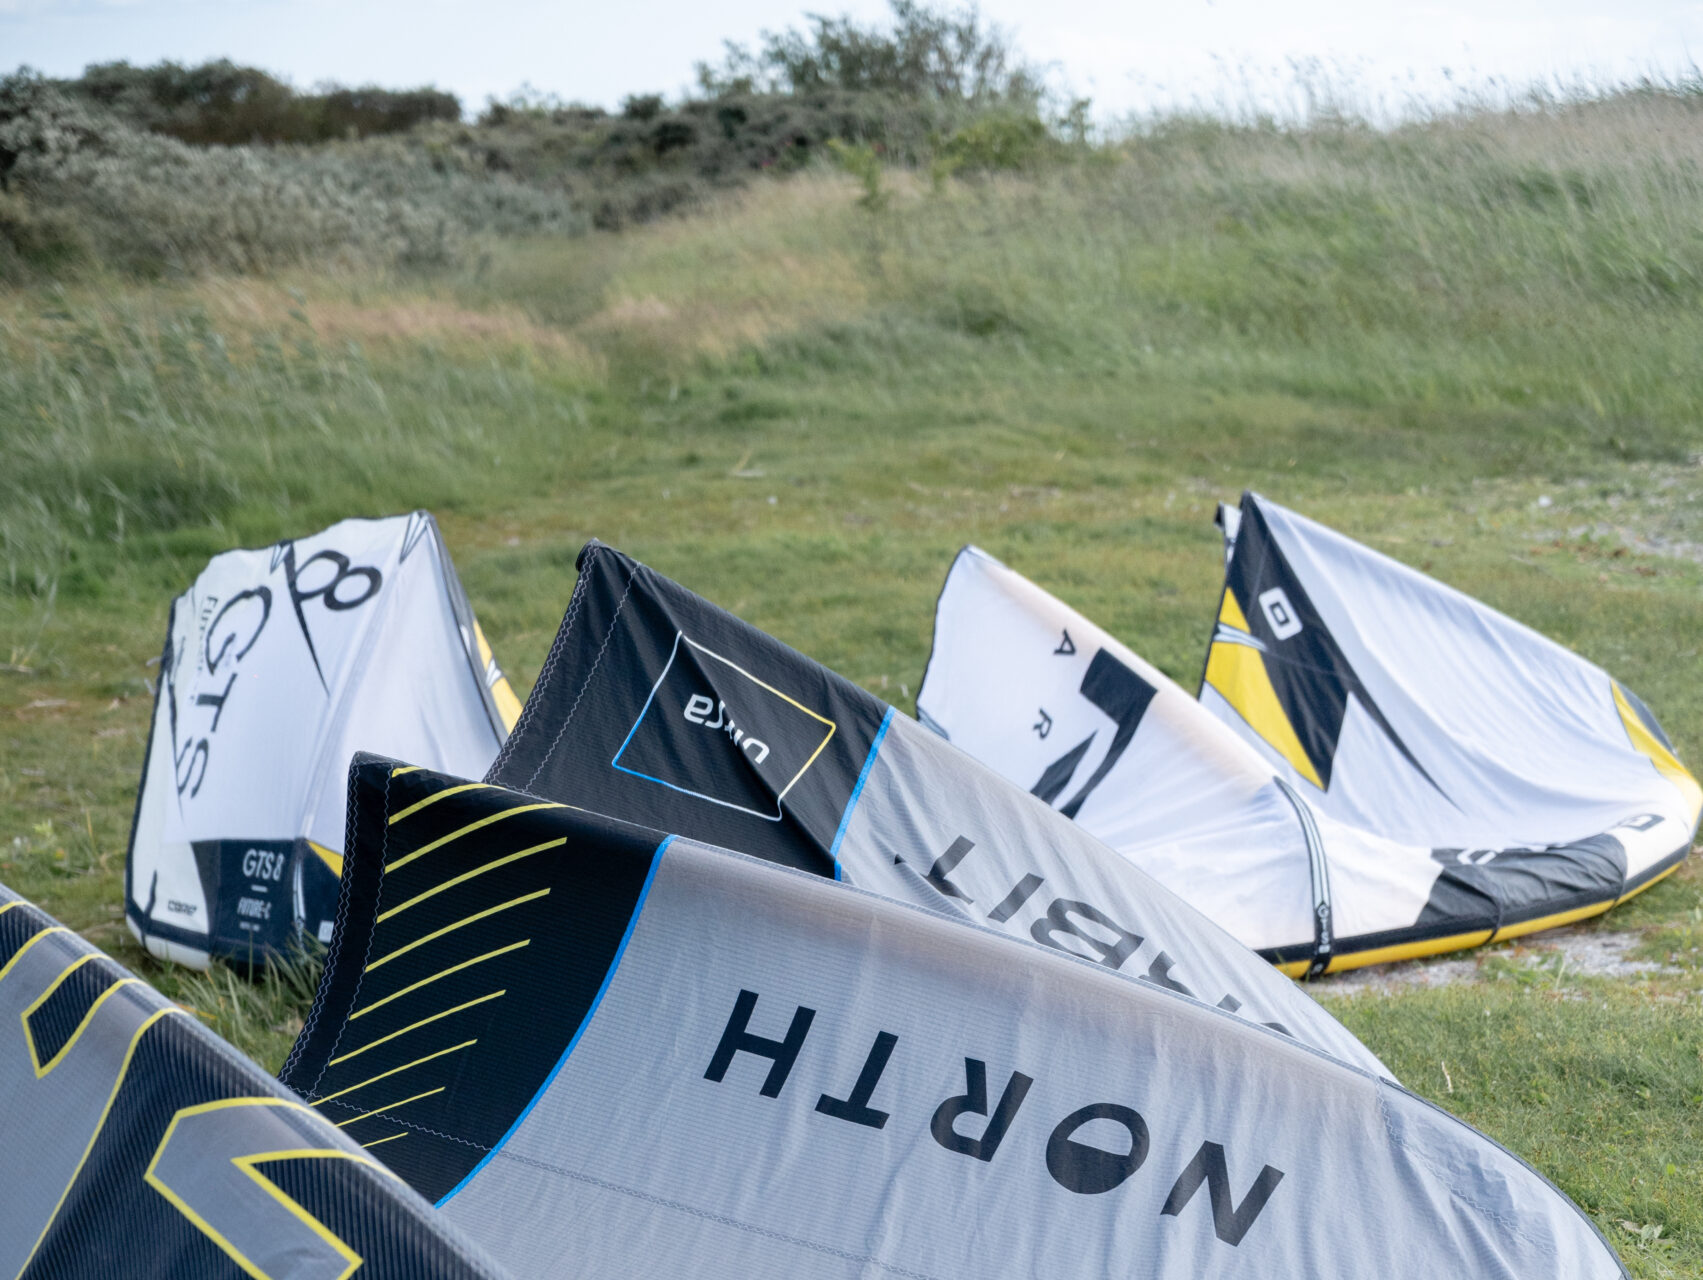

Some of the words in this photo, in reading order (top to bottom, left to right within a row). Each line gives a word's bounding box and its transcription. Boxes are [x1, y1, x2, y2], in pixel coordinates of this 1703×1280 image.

[297, 550, 383, 611] 8
[175, 586, 272, 800] GTS
[894, 834, 1294, 1038] BIT
[703, 988, 1285, 1248] NORTH
